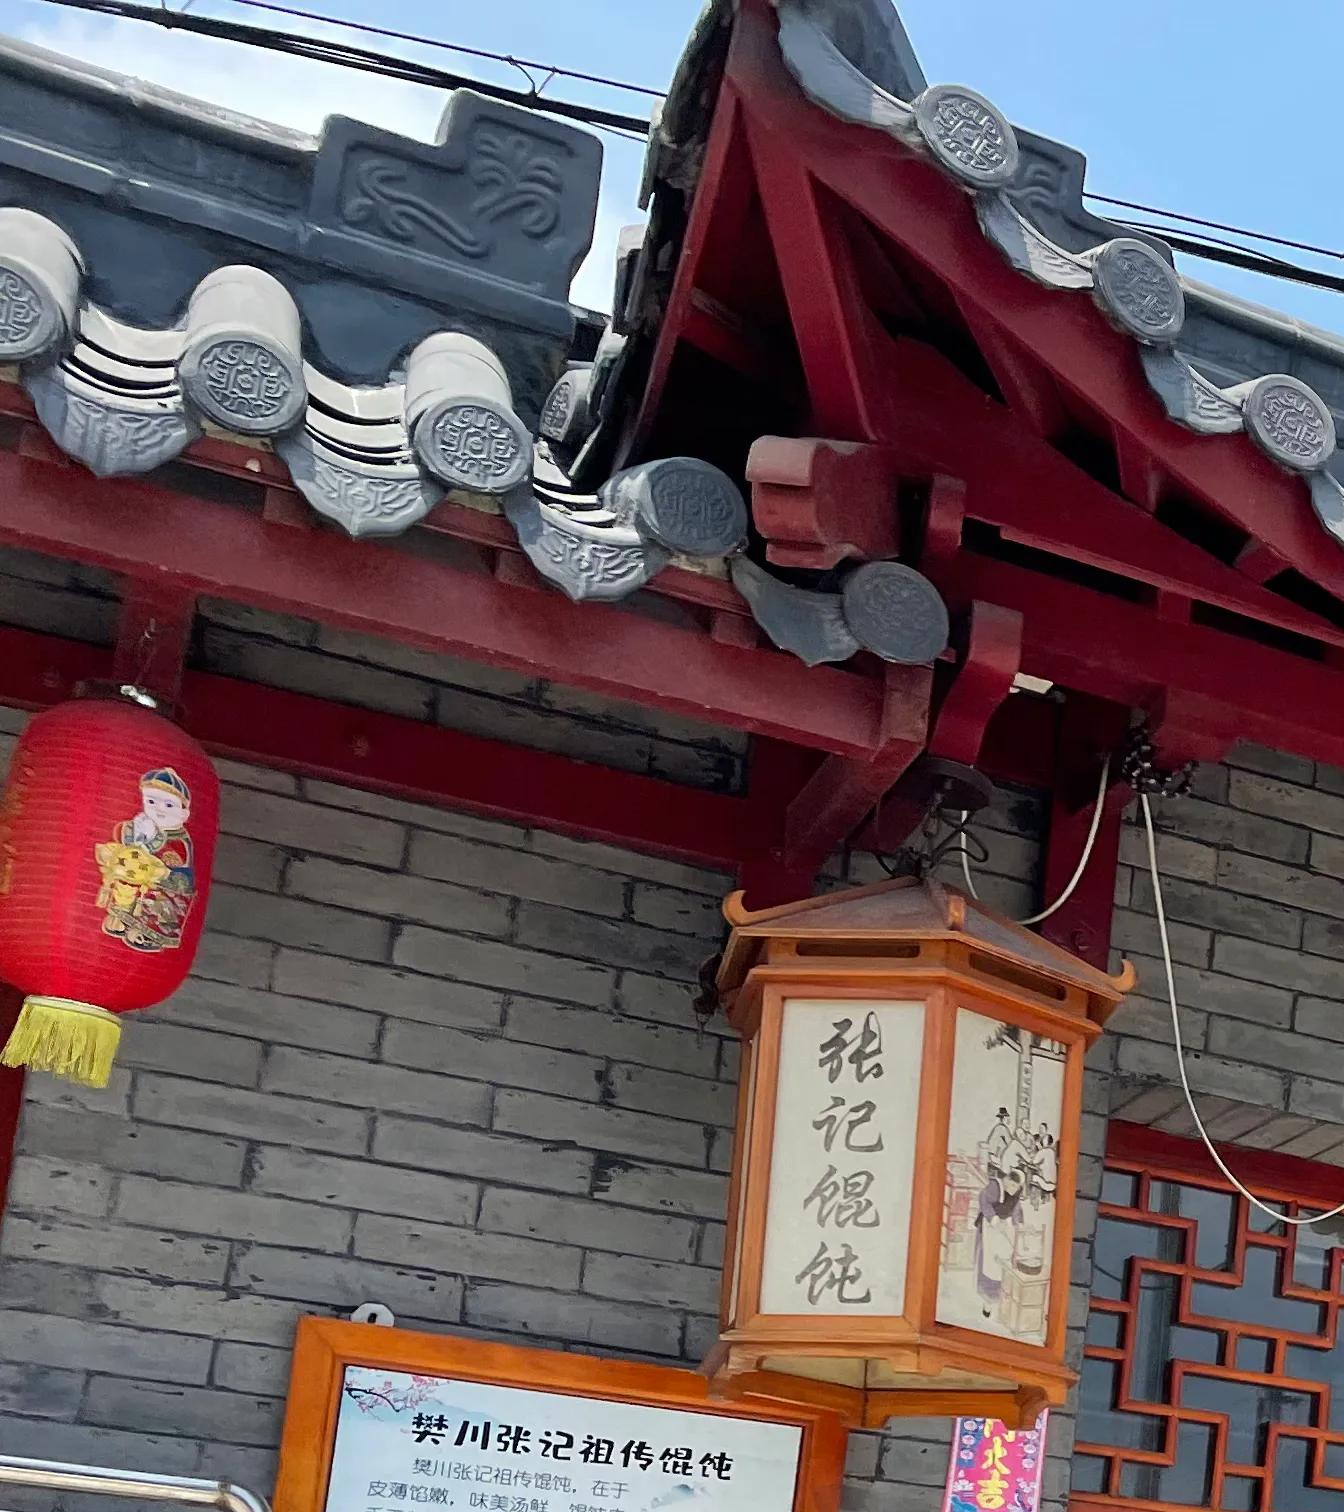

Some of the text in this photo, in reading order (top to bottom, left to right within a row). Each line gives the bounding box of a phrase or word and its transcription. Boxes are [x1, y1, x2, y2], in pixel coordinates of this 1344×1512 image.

[795, 1010, 884, 1305] 张记馄饨
[411, 1412, 734, 1481] 樊川张记祖传馄饨
